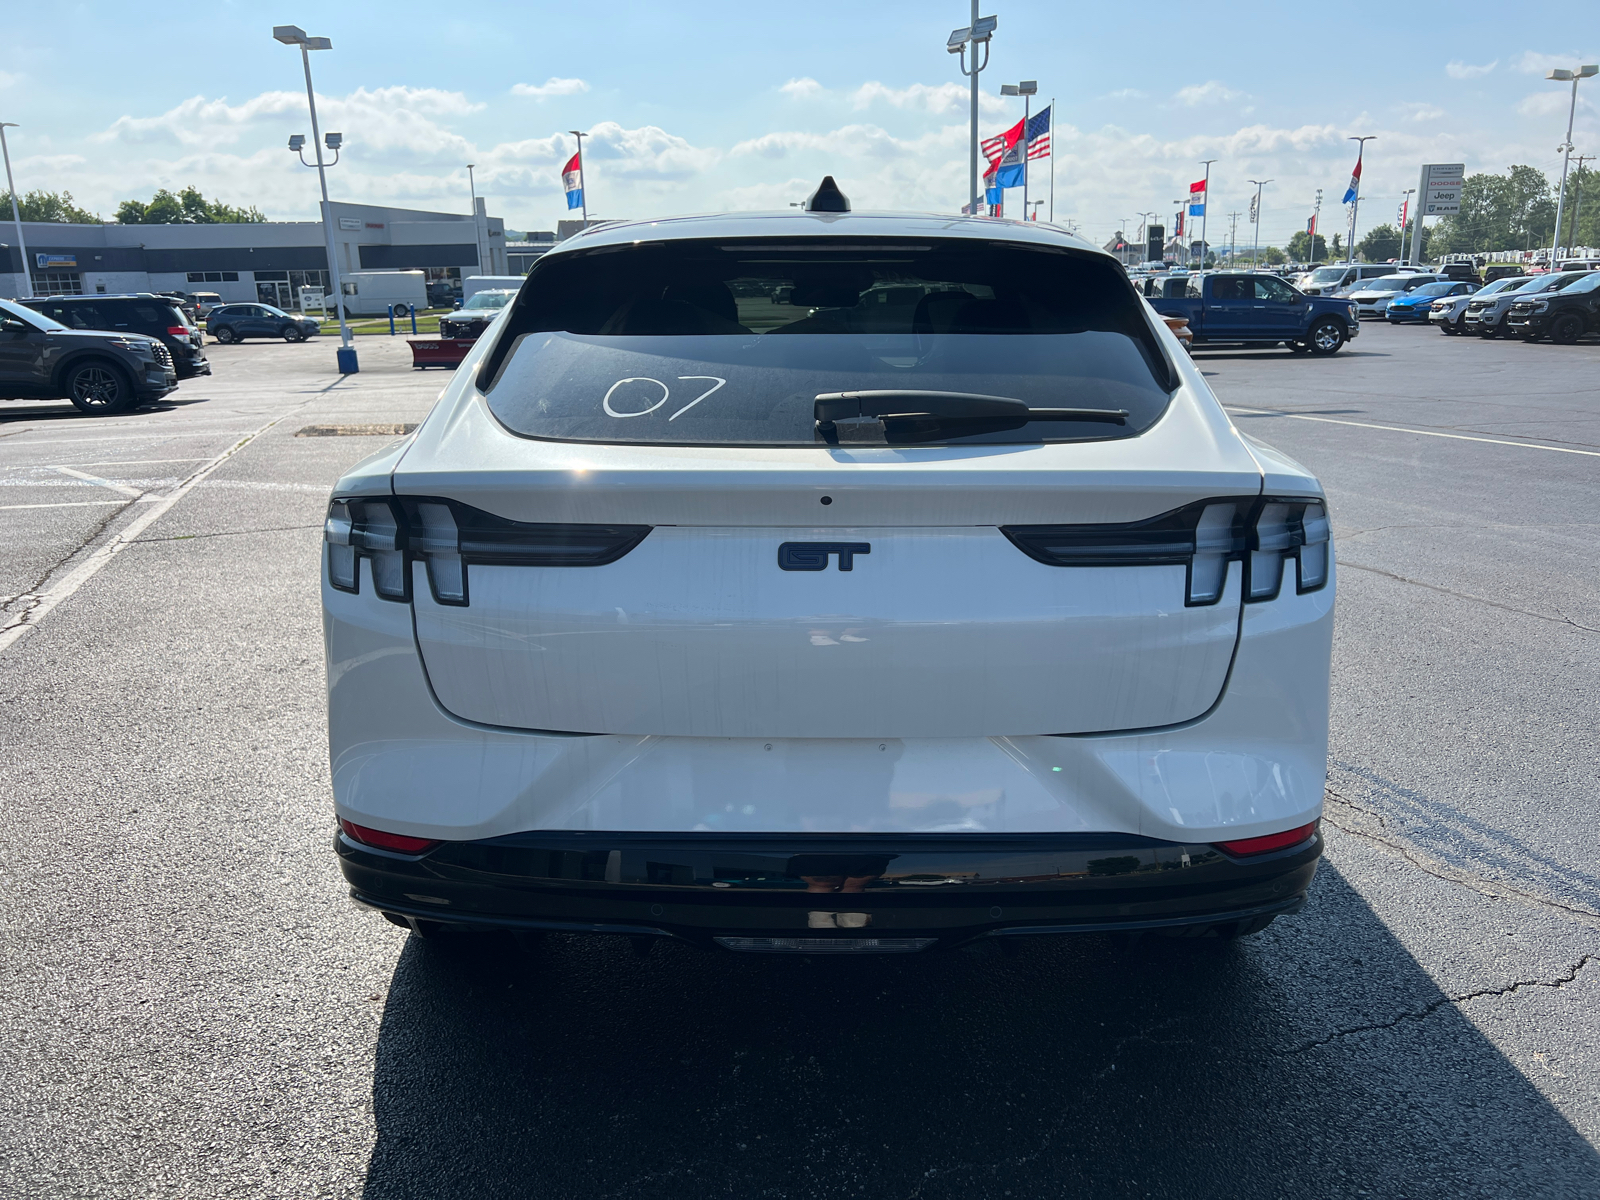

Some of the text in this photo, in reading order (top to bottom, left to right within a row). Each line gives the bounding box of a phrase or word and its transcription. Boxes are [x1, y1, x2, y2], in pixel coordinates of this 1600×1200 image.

[1433, 191, 1455, 201] Jeep
[602, 375, 727, 422] 07
[777, 541, 872, 572] GT
